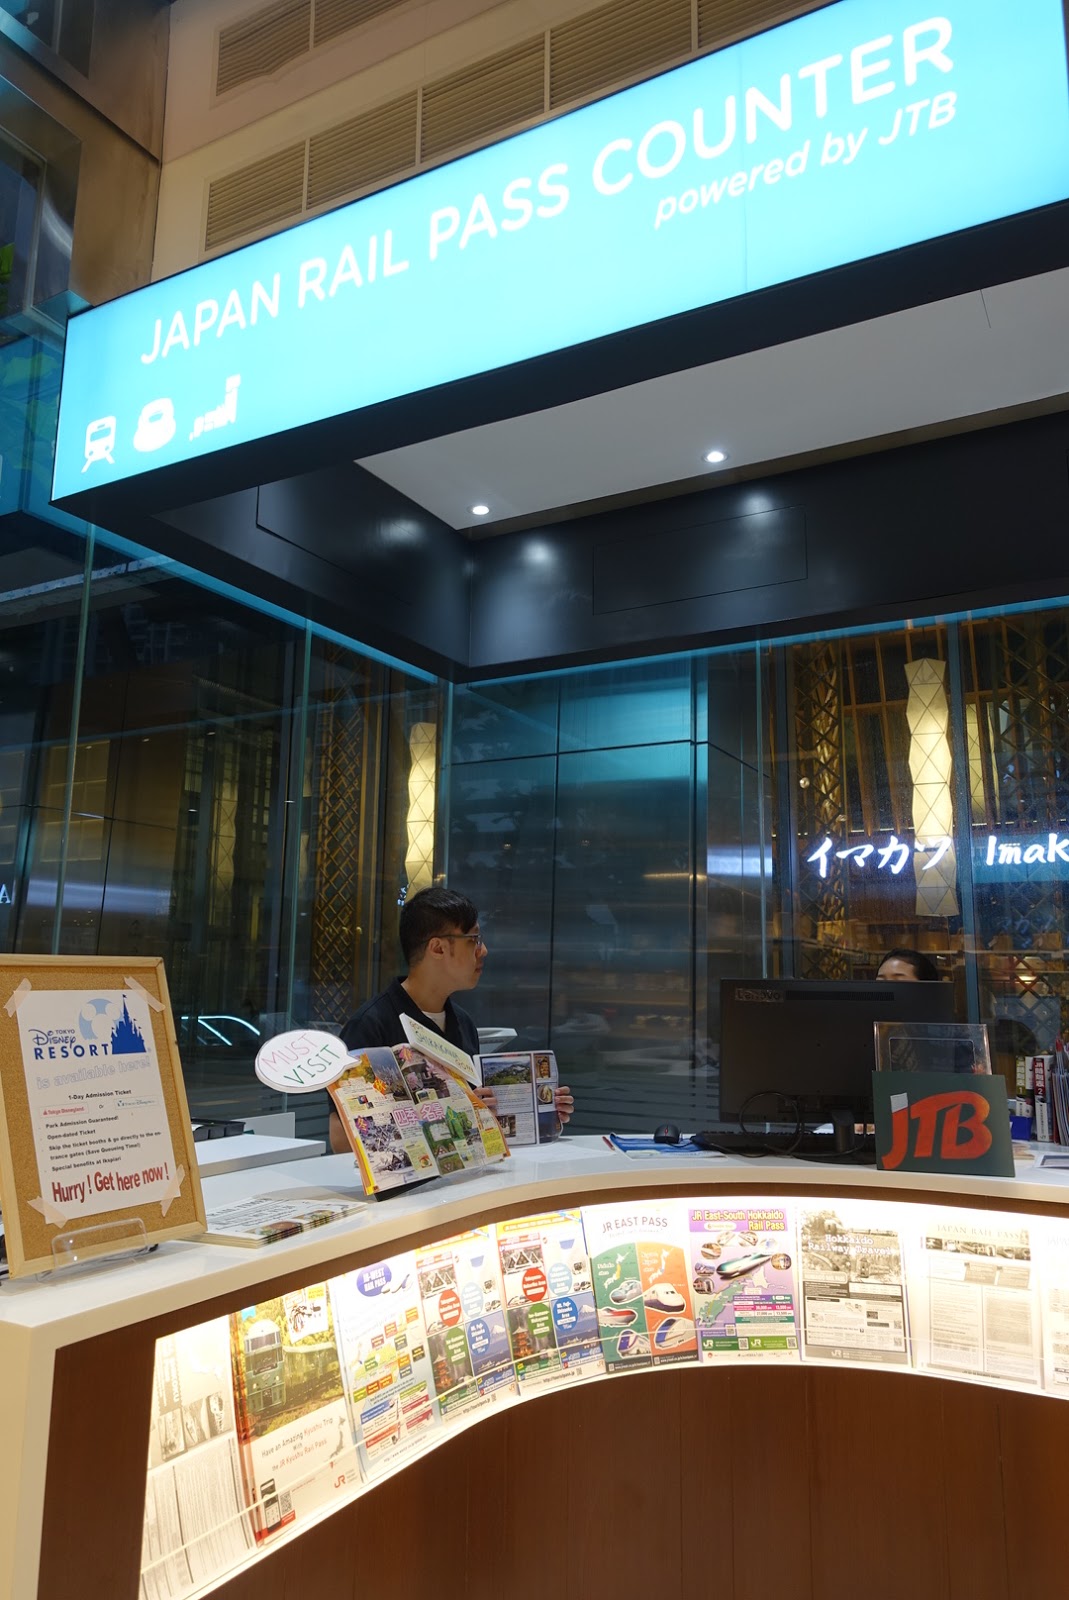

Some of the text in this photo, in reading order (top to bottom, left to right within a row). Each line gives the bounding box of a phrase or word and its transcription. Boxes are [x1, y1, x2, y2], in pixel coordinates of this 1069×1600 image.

[654, 91, 957, 229] powered by JTB
[140, 16, 954, 364] JAPAN RAIL PASS COUNTER
[34, 1043, 108, 1060] RESORT
[261, 1033, 319, 1073] MUST
[283, 1043, 341, 1085] VISIT
[36, 1055, 151, 1090] is available here!
[68, 1093, 84, 1101] 1-Day
[85, 1090, 114, 1099] Admission
[60, 1119, 87, 1128] Admission
[88, 1115, 119, 1124] Guaranteed!
[47, 1131, 78, 1140] Open-dated
[881, 1090, 993, 1170] JTB
[120, 1134, 139, 1142] directly
[51, 1164, 72, 1172] Special
[73, 1160, 95, 1168] benefits
[51, 1181, 85, 1204] Hurry
[94, 1170, 115, 1192] Get
[116, 1171, 140, 1191] here
[142, 1166, 163, 1185] now
[692, 1208, 785, 1221] JR East-South Hokkaido
[602, 1221, 612, 1234] JR
[614, 1216, 638, 1229] EAST
[641, 1216, 668, 1228] PASS
[748, 1220, 785, 1231] Rail Pass
[937, 1224, 966, 1234] JAPAN
[971, 1227, 992, 1236] RAIL
[825, 1234, 874, 1245] Hokkaido
[808, 1241, 850, 1255] Railway
[703, 1339, 713, 1348] JR
[751, 1339, 762, 1348] JR
[261, 1448, 275, 1458] Have
[282, 1431, 304, 1447] Amazing
[303, 1423, 323, 1437] Kyushu
[323, 1417, 333, 1426] Trip
[279, 1459, 286, 1468] JR
[285, 1451, 304, 1466] Kyushu
[304, 1445, 314, 1454] Rail
[314, 1439, 327, 1449] Pass
[334, 1474, 346, 1488] JR
